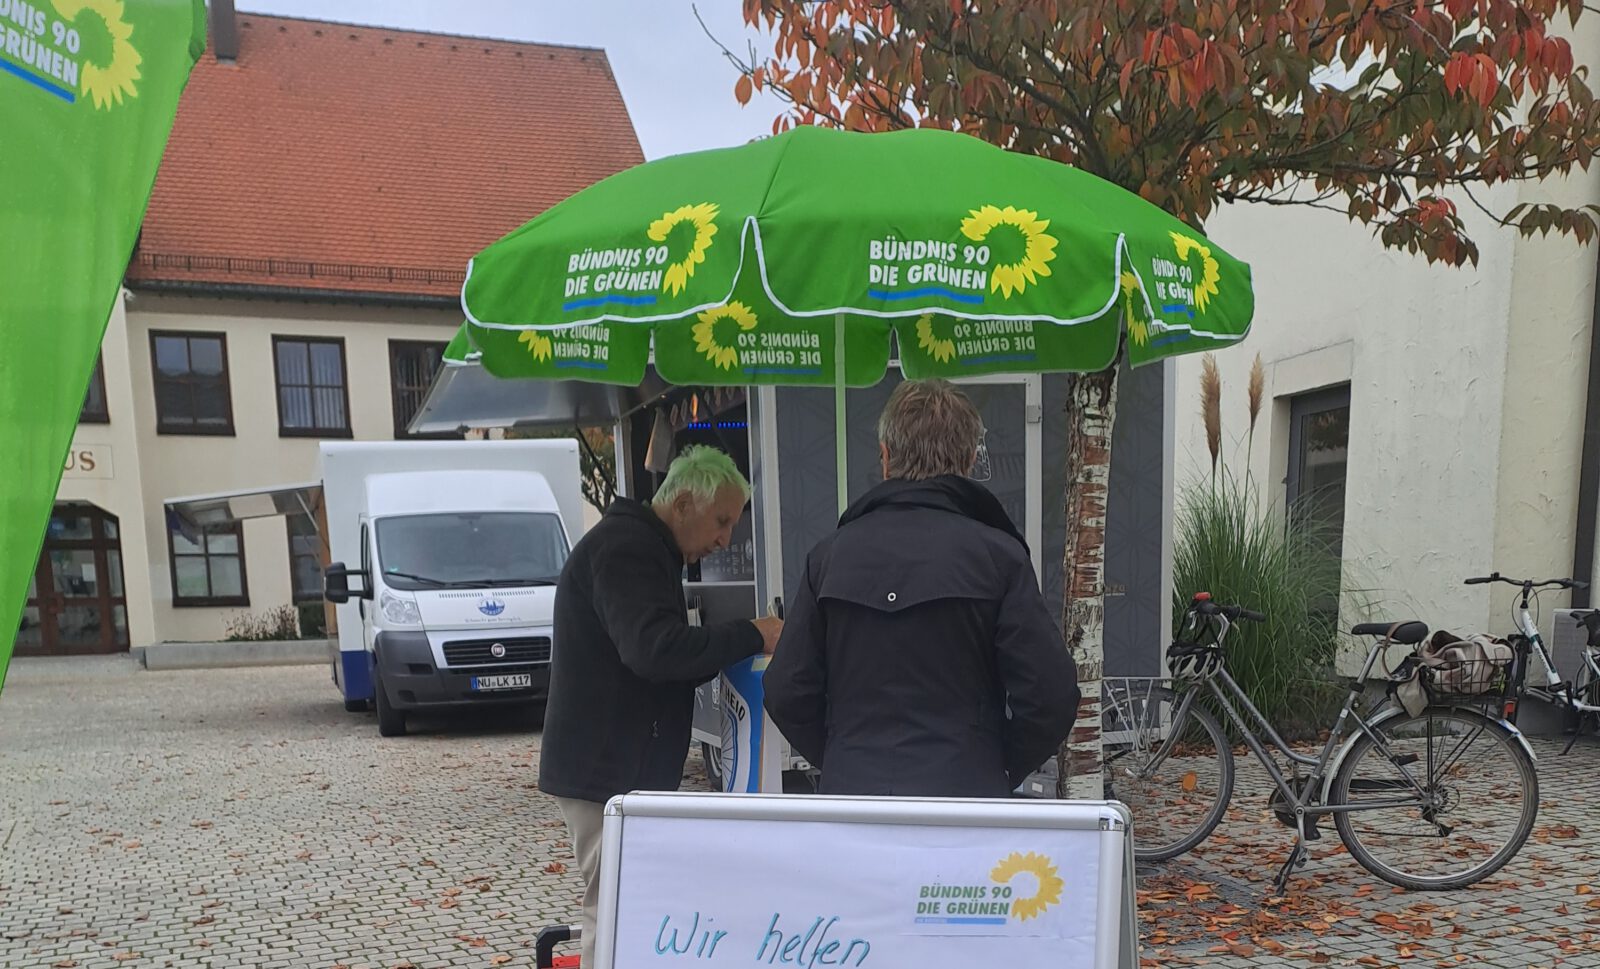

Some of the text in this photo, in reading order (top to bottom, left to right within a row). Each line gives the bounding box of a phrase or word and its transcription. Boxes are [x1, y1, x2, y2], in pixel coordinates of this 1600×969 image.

[52, 21, 80, 54] 90
[568, 245, 669, 273] BÜNDNIS 90
[870, 235, 991, 266] BÜNDNIS 90
[564, 266, 663, 298] DIE GRÜNEN
[869, 259, 987, 289] DIE GRÜNEN
[1179, 265, 1192, 283] 90
[477, 675, 530, 688] NU LK 117
[919, 882, 1012, 899] BÜNDNIS 90
[916, 899, 1010, 915] DIE GRÜNEN
[654, 911, 871, 969] Wir helfen
